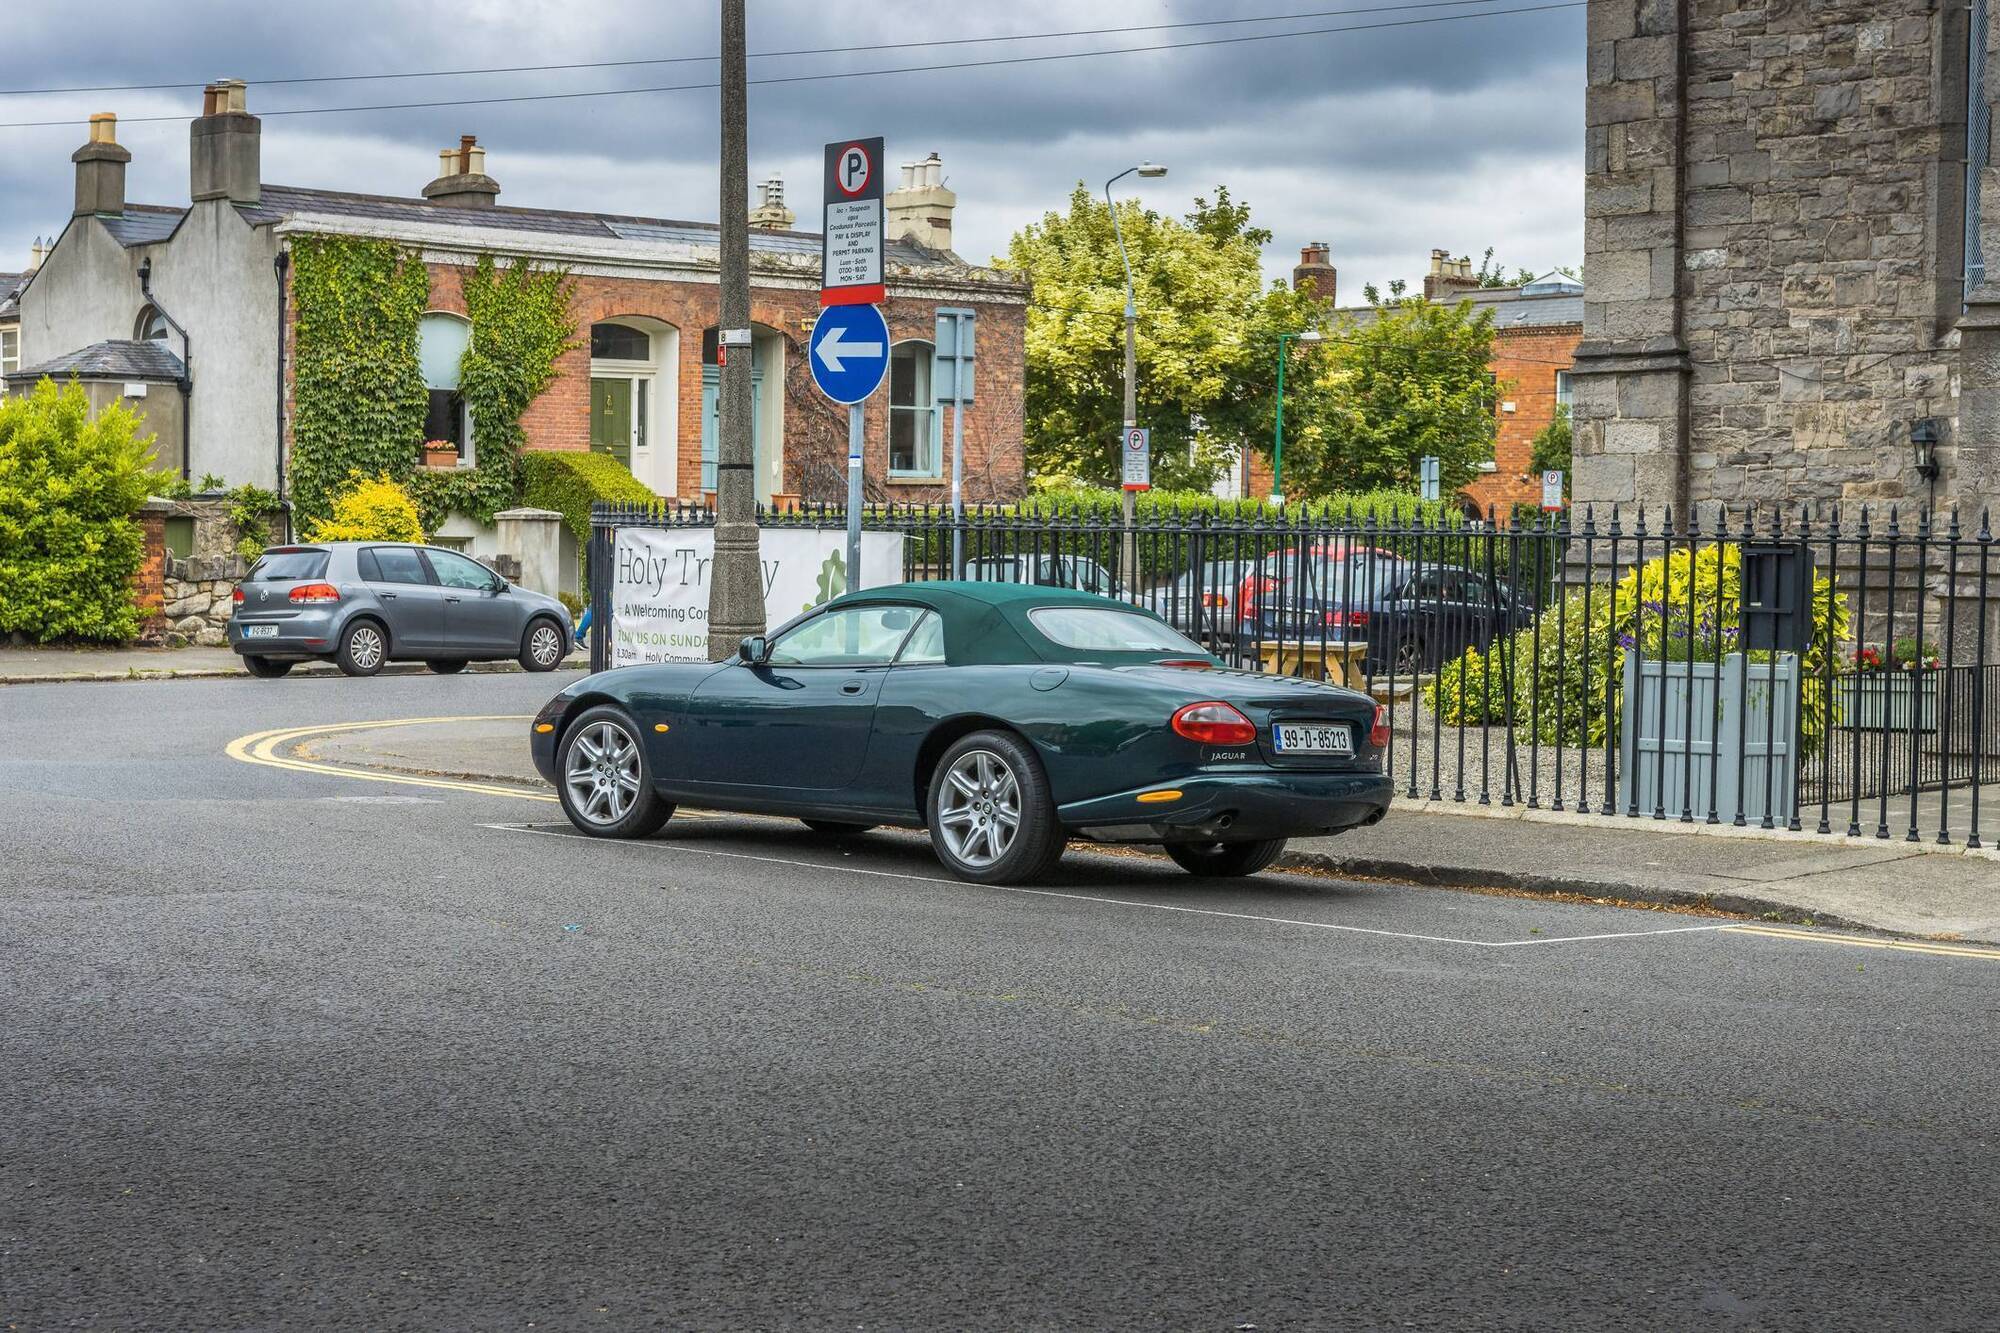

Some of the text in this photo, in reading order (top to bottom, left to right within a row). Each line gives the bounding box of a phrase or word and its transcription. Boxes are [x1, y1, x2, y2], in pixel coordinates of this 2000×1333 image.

[848, 153, 862, 187] P
[850, 230, 871, 239] DISPLAY
[832, 247, 874, 257] PERMIT PARKING
[619, 545, 667, 598] Holy
[624, 603, 631, 616] A
[631, 603, 685, 622] Welcoming
[636, 632, 649, 645] US
[651, 633, 666, 645] ON
[670, 634, 709, 648] SUNDA
[645, 652, 663, 663] Holy
[1284, 729, 1347, 749] 99-D-85213
[1211, 752, 1246, 761] JAGUAR
